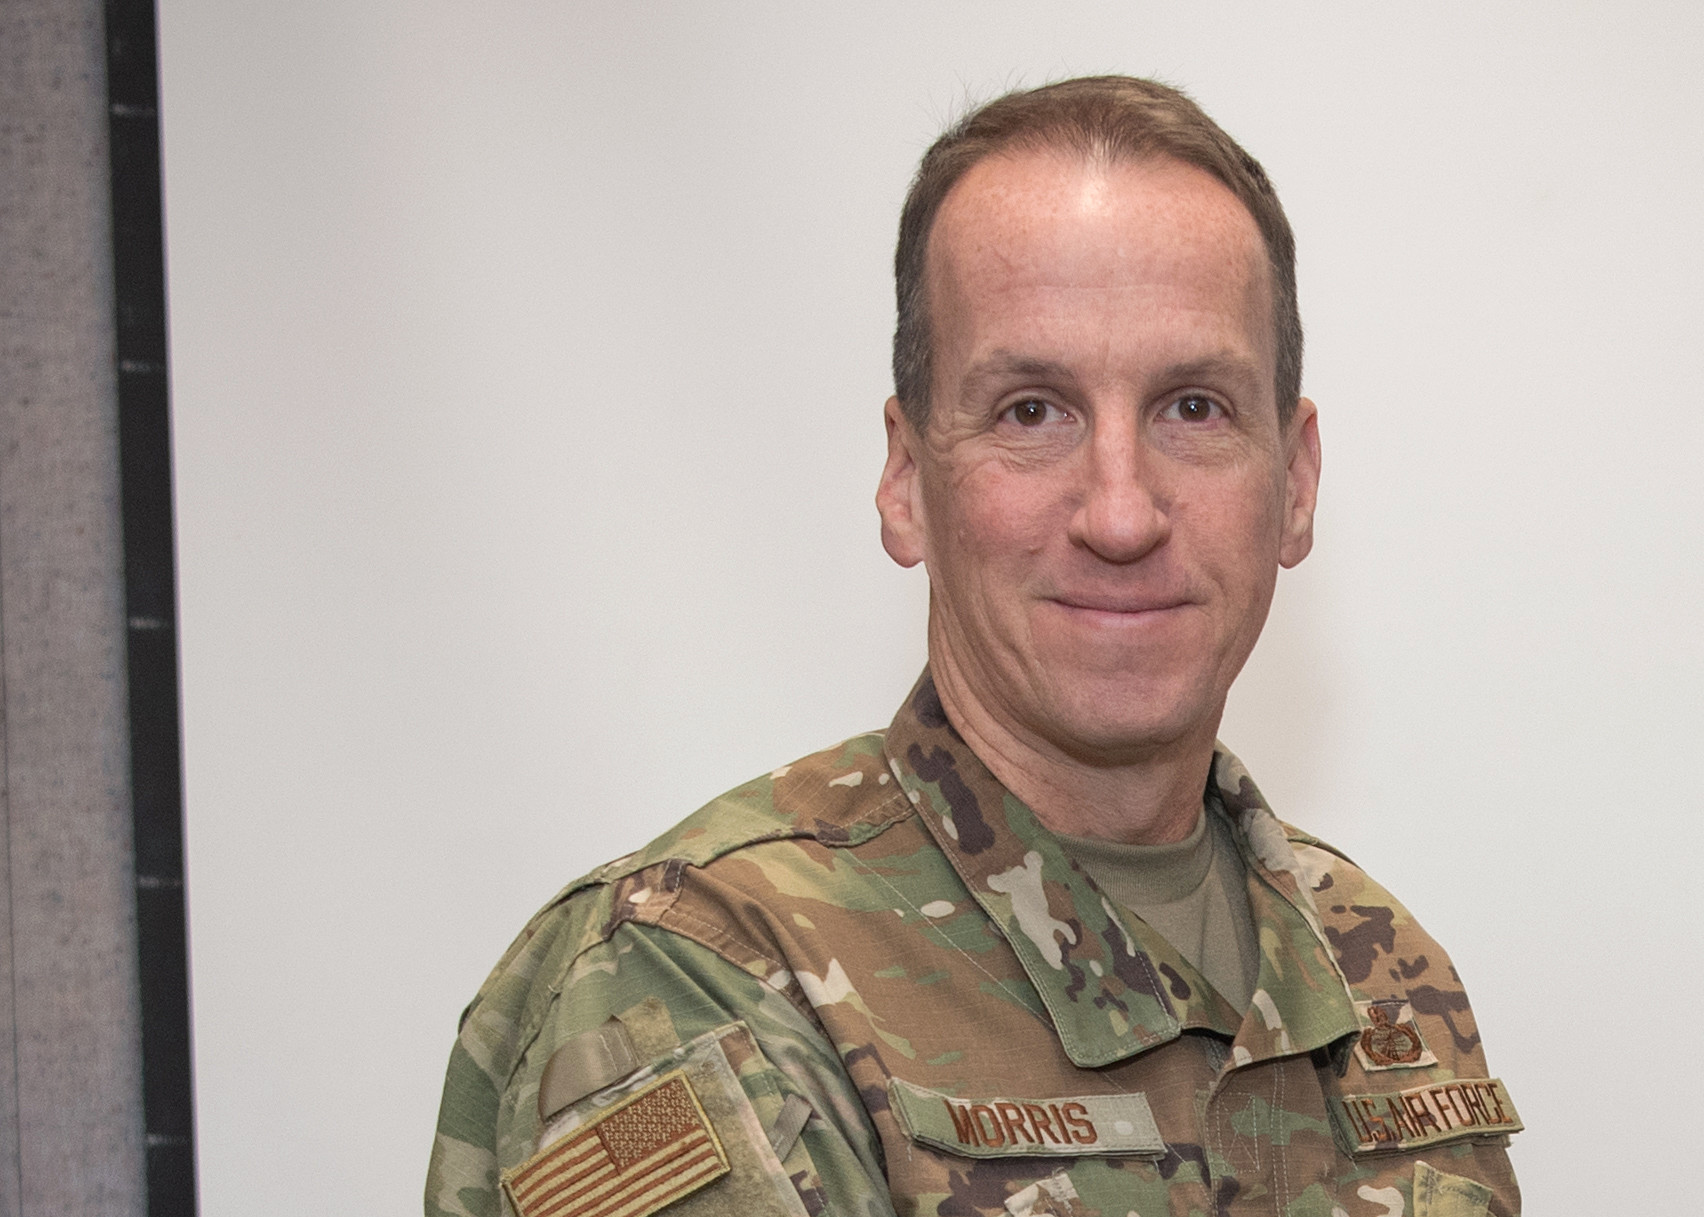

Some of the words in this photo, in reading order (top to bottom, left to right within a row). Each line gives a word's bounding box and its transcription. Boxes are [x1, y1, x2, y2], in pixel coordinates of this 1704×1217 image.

[943, 1098, 1098, 1148] MORRIS
[1386, 1093, 1442, 1141] AIR
[1429, 1083, 1514, 1130] FORCE
